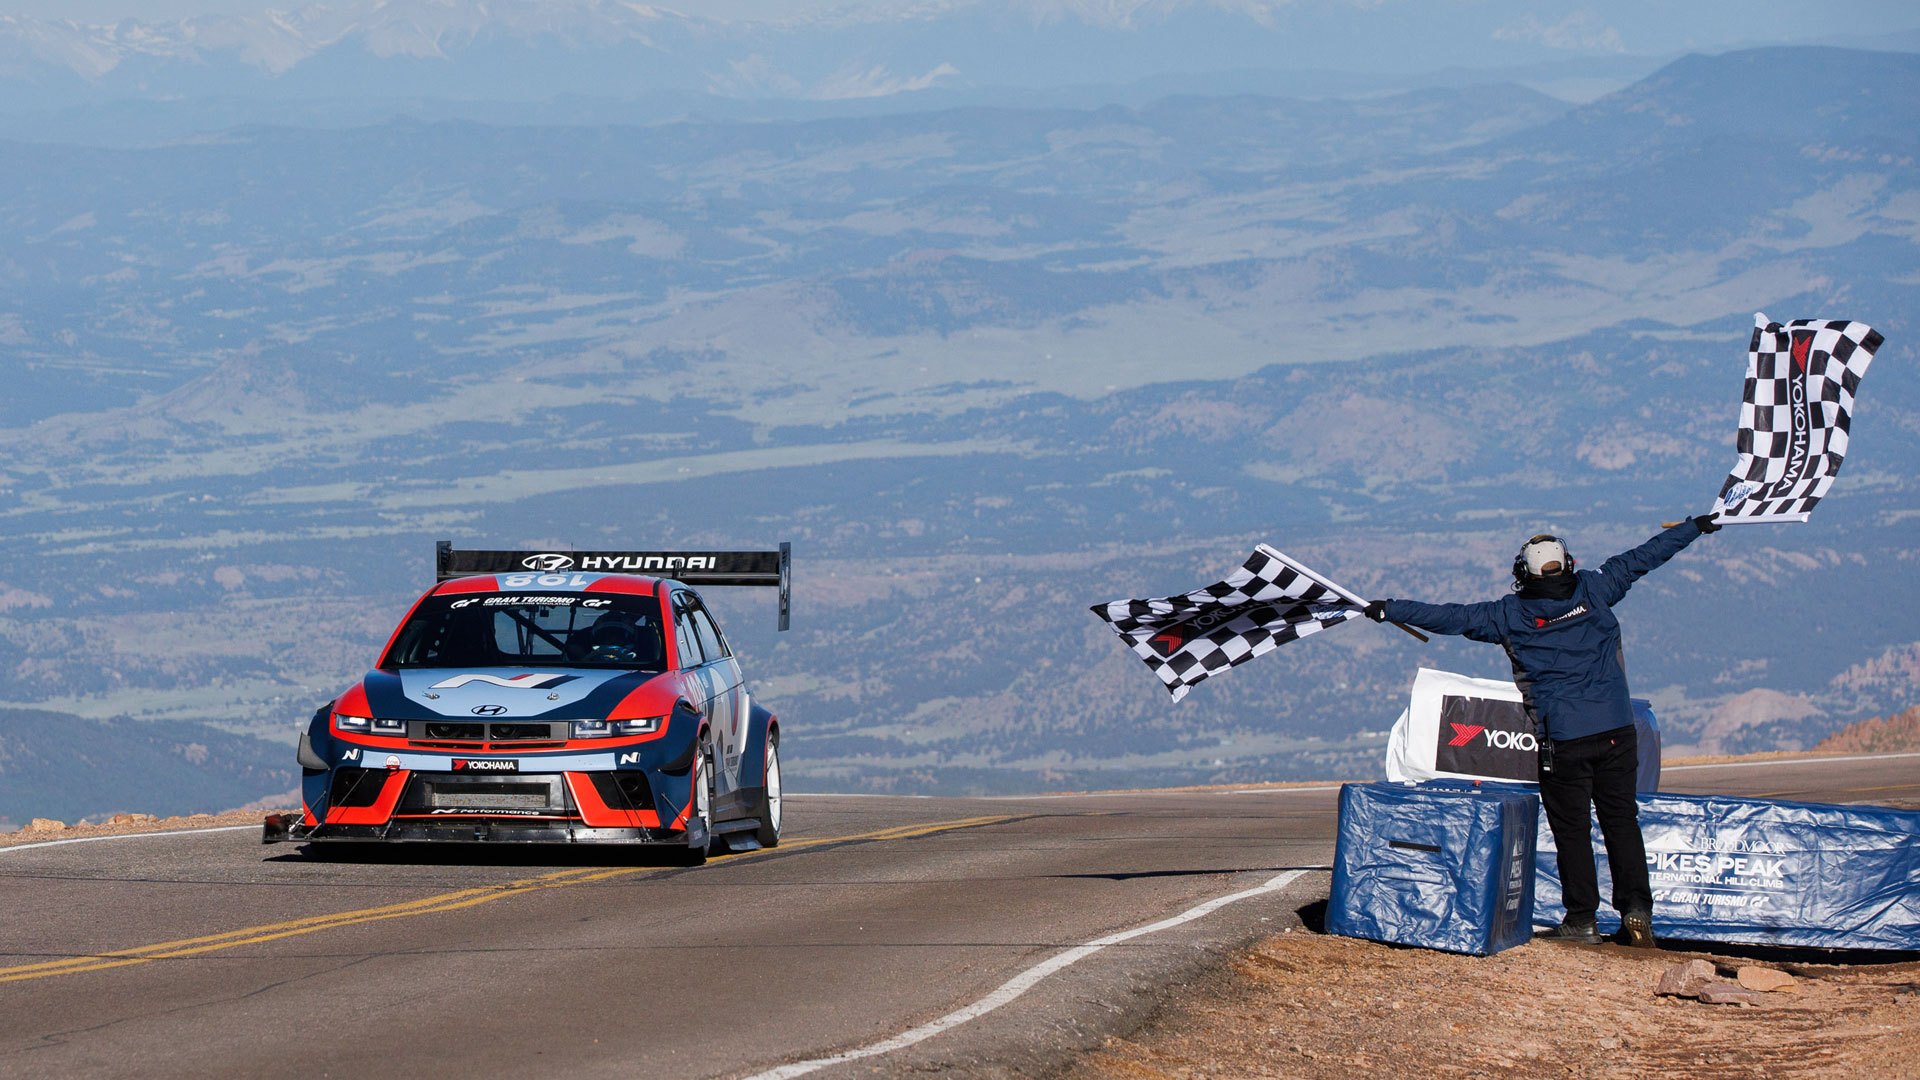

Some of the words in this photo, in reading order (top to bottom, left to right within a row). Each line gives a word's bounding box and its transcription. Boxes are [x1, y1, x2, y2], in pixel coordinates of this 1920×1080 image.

[1779, 373, 1806, 492] YOKOHAMA
[581, 556, 716, 569] HYUNDAI
[504, 573, 588, 587] 198
[484, 596, 519, 604] GRAN
[521, 596, 576, 604] TURISMO
[1484, 728, 1539, 752] YOKO
[467, 760, 516, 770] YOKOHAMA
[1646, 852, 1712, 874] PIKES
[1717, 857, 1785, 878] PEAK
[1649, 871, 1723, 885] TERNATIONAL
[1724, 876, 1748, 886] HILL
[1749, 878, 1784, 888] CLIMB
[1671, 892, 1701, 905] GRAN
[1702, 893, 1748, 907] TURISMO
